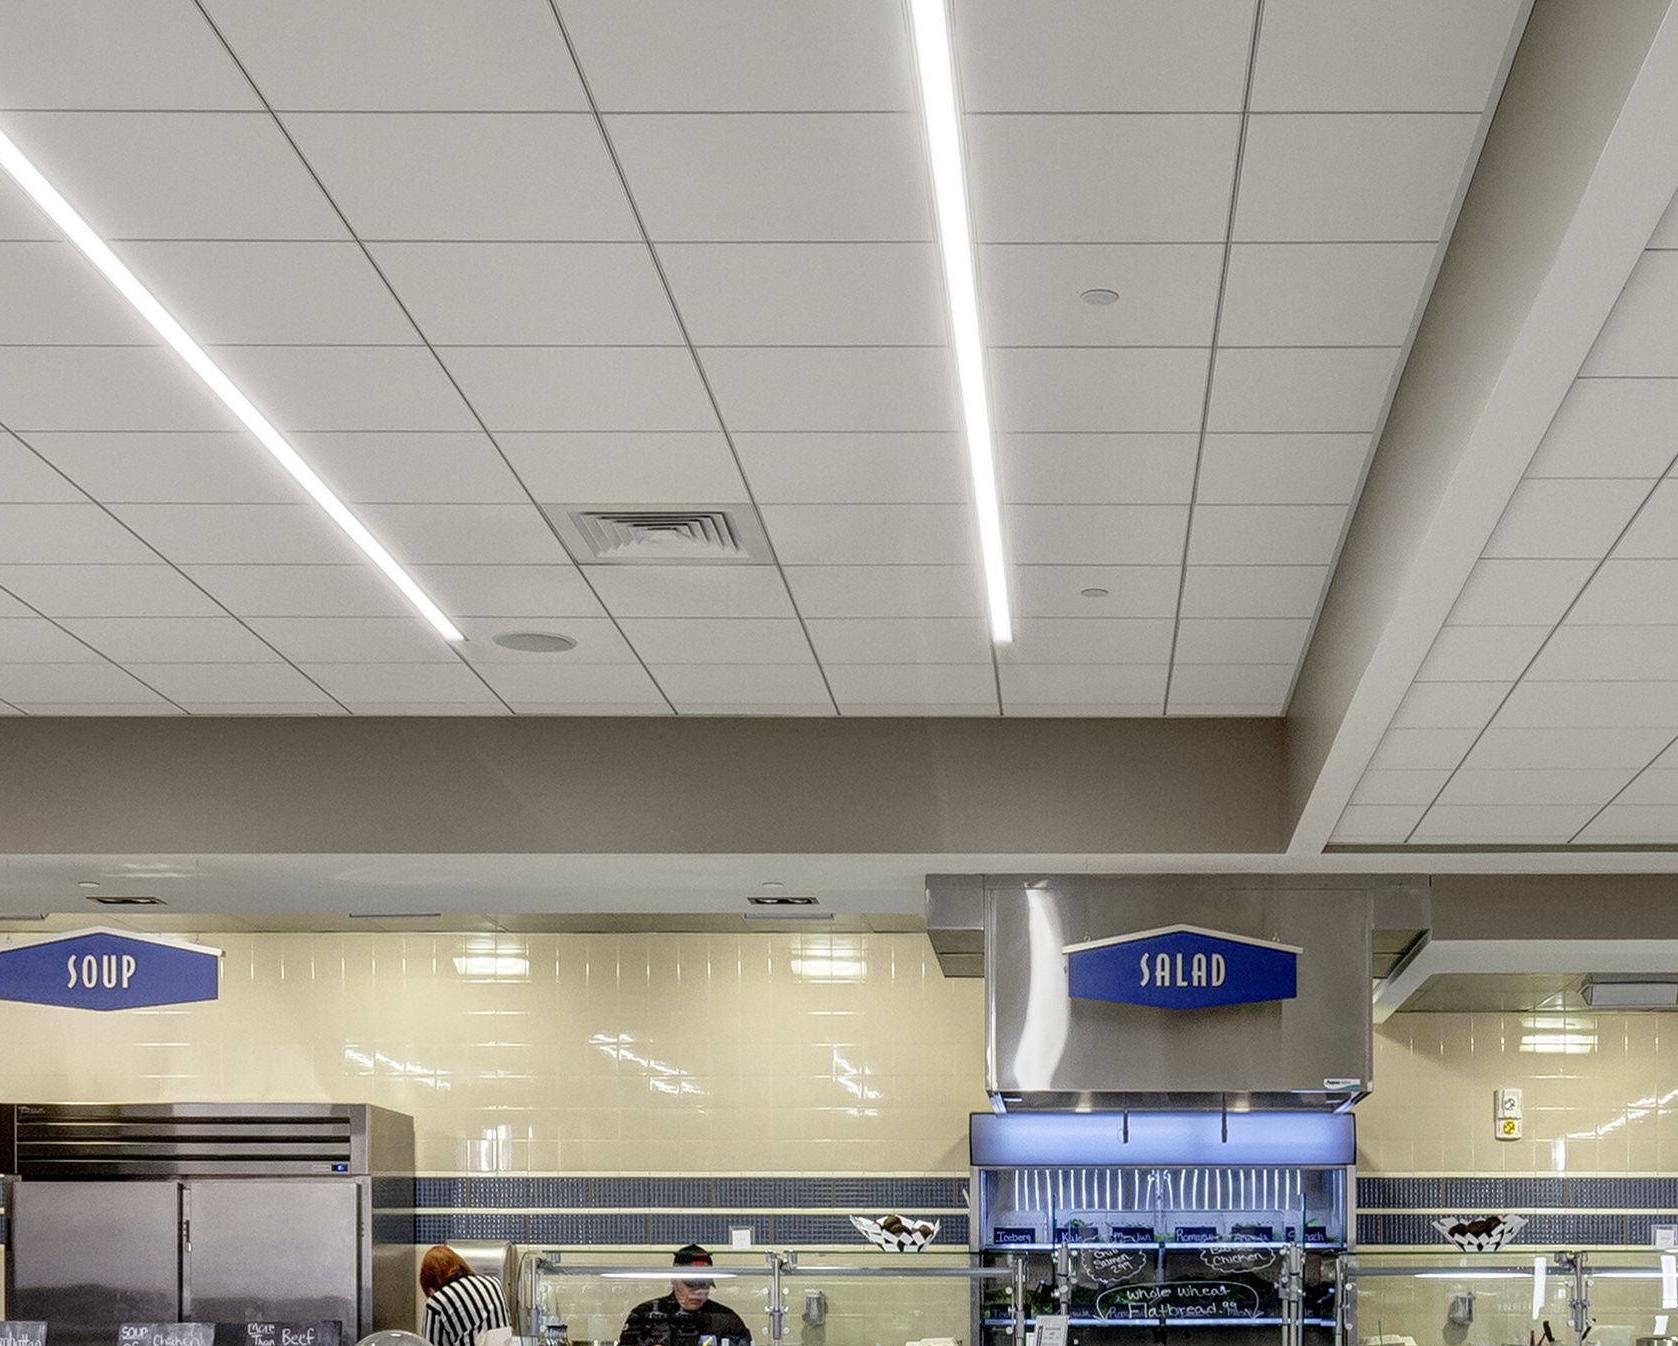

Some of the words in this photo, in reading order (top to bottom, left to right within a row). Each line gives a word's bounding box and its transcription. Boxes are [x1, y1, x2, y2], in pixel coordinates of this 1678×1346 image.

[67, 953, 137, 990] SOUP
[1139, 952, 1227, 988] SALAD
[282, 1327, 316, 1346] Beef
